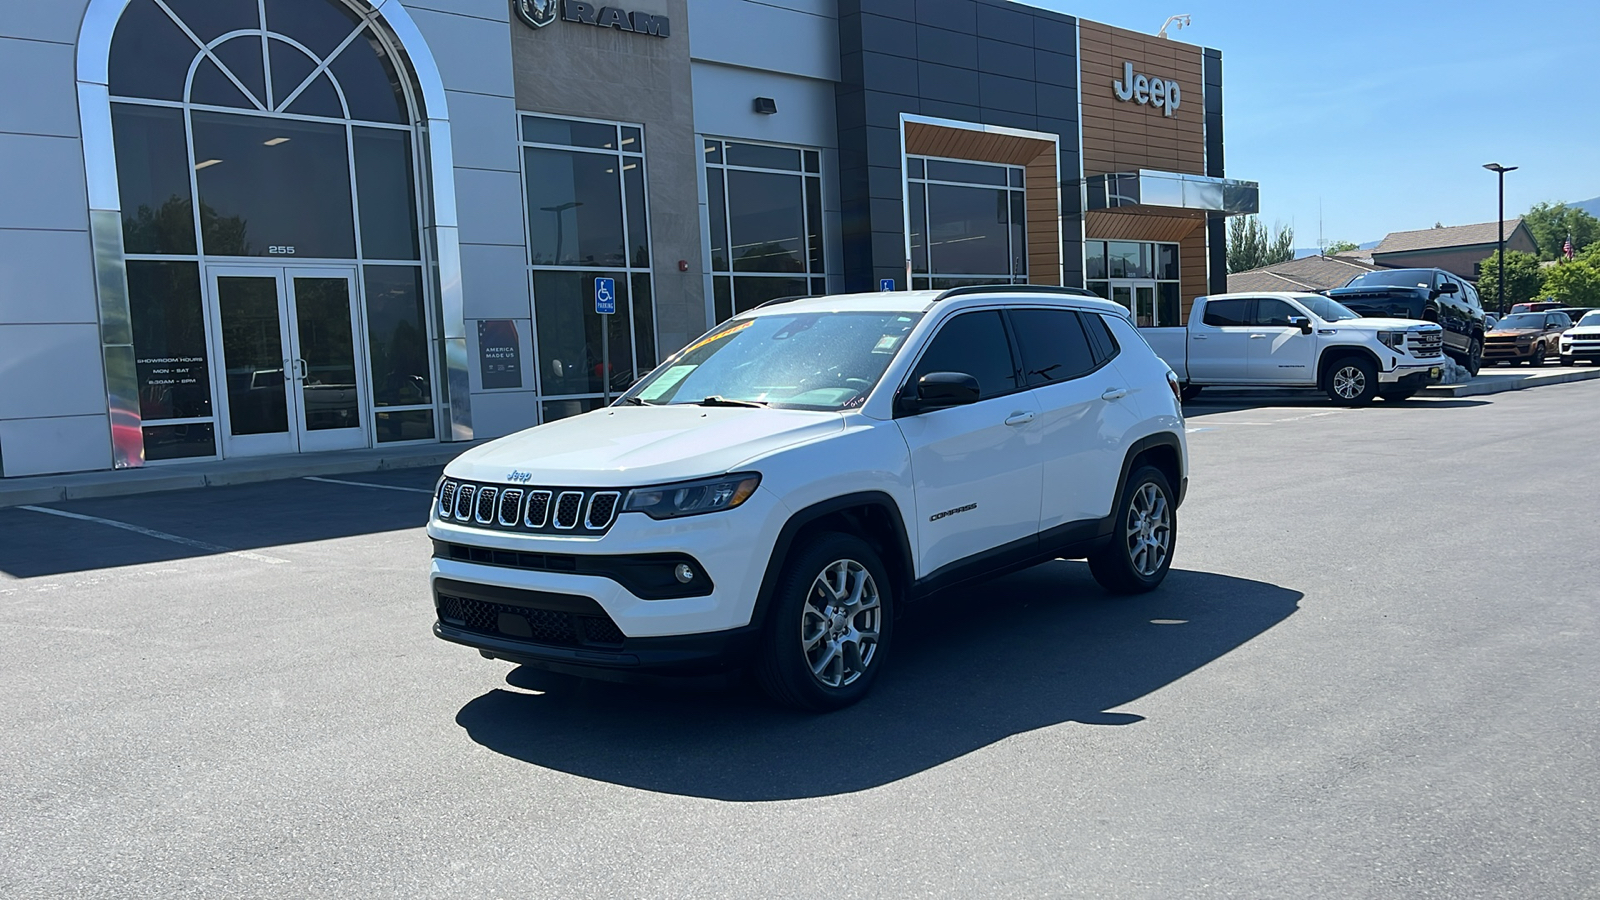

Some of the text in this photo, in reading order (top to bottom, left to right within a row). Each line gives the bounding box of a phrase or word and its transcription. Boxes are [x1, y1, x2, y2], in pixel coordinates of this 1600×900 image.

[561, 0, 670, 38] RAM
[1112, 61, 1181, 117] Jeep
[269, 245, 295, 254] 255
[506, 469, 532, 484] Jeep
[929, 502, 978, 522] COMPASS
